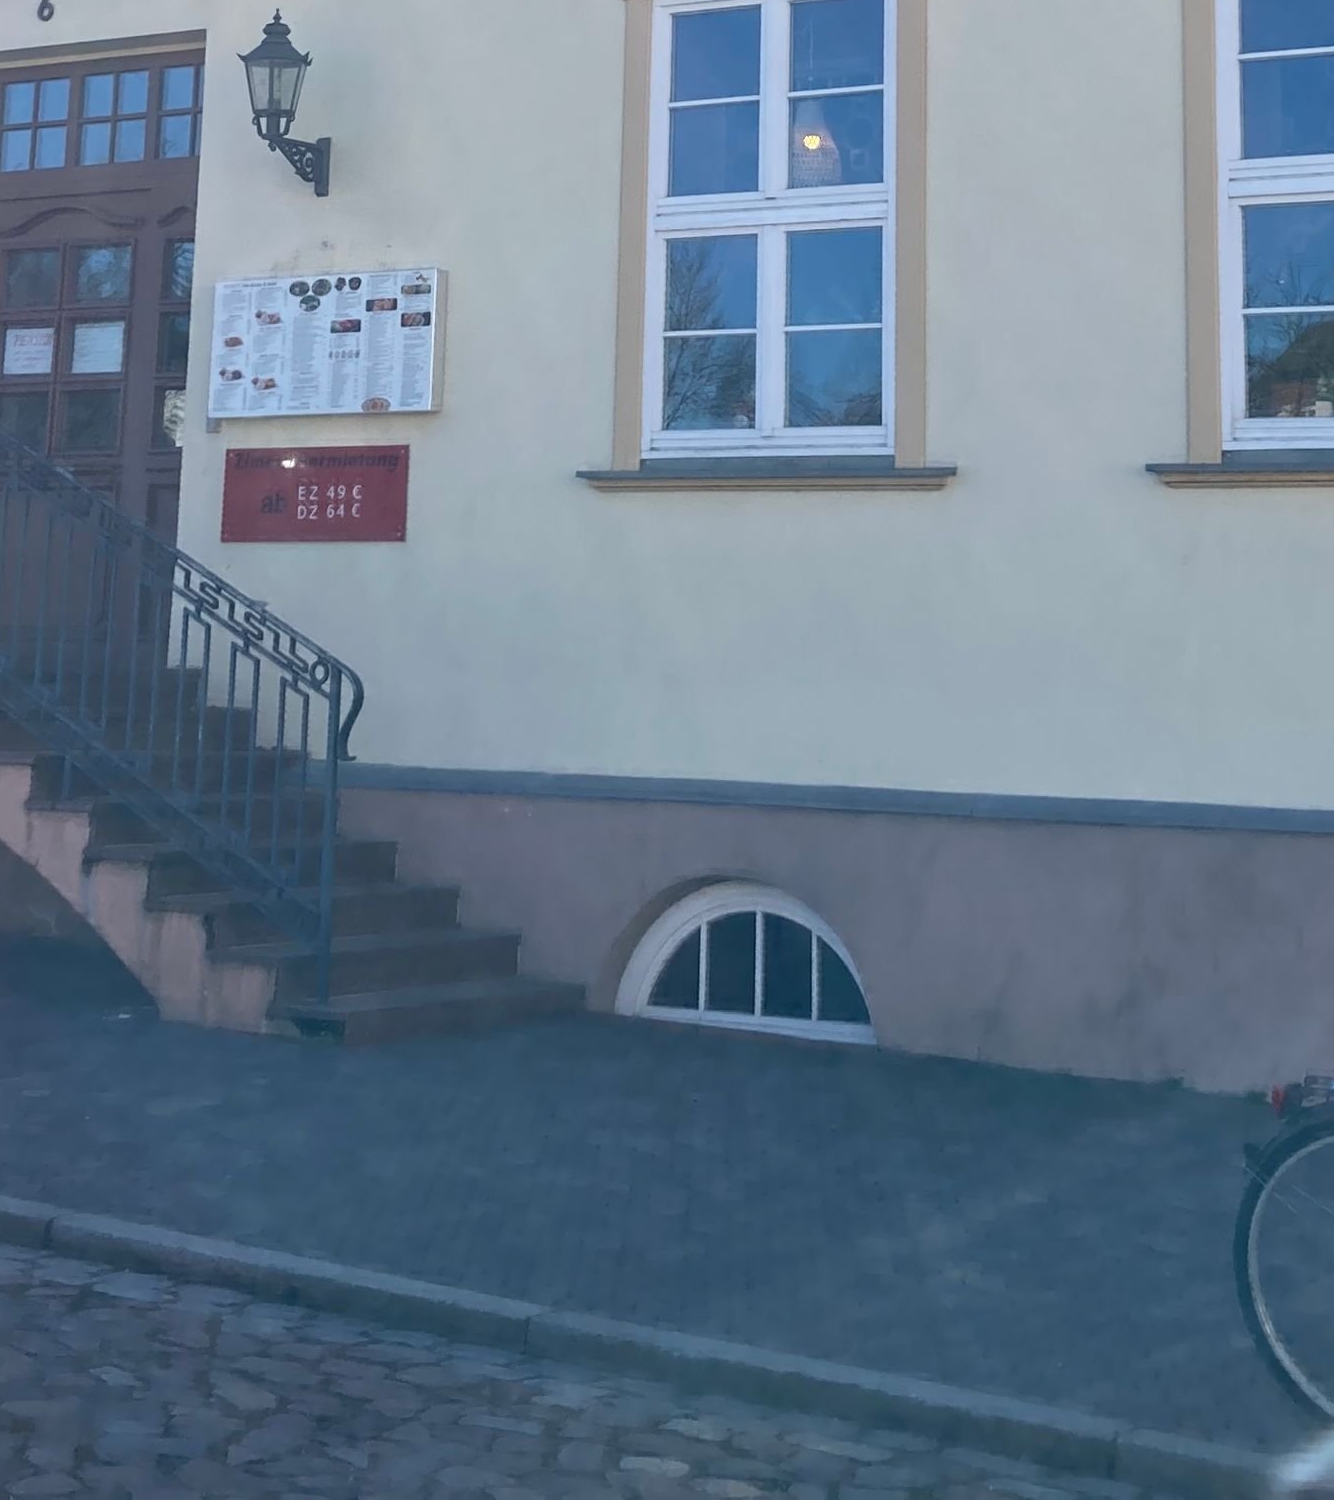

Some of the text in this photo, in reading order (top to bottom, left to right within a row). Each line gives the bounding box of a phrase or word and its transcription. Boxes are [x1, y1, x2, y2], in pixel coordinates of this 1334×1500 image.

[297, 484, 362, 501] EZ 49 €
[296, 502, 361, 520] DZ 64 €
